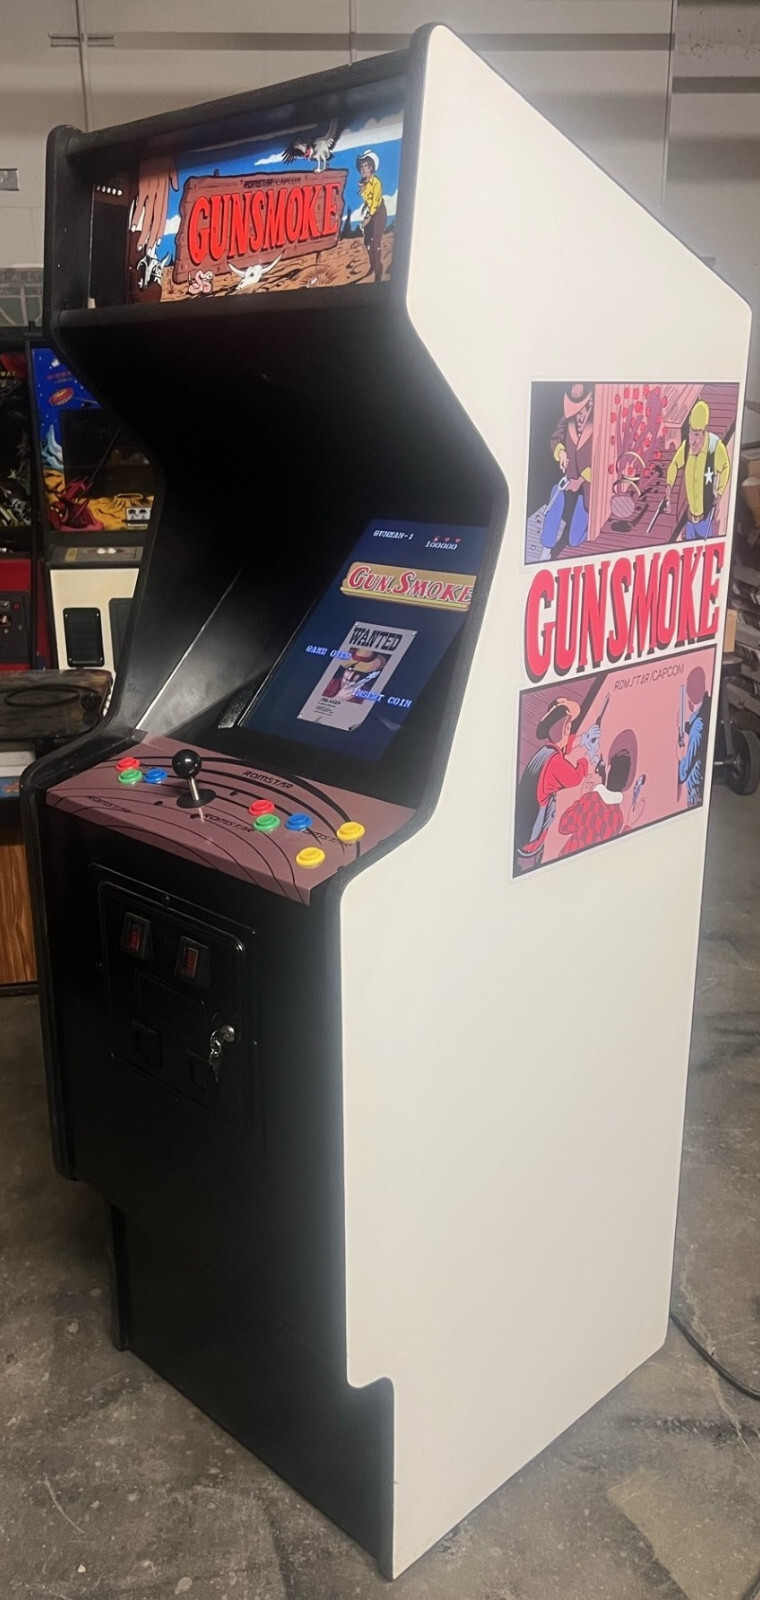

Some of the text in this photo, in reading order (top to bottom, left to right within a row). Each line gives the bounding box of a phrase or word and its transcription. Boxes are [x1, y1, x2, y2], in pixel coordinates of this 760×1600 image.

[188, 184, 338, 264] GUNSMOKE
[425, 540, 458, 551] 100000
[526, 543, 724, 683] GUNSMOKE
[348, 627, 403, 651] WANTED
[305, 645, 352, 661] GAME OVER
[352, 688, 412, 709] INSERT COIN
[242, 770, 294, 789] ROMSTAR
